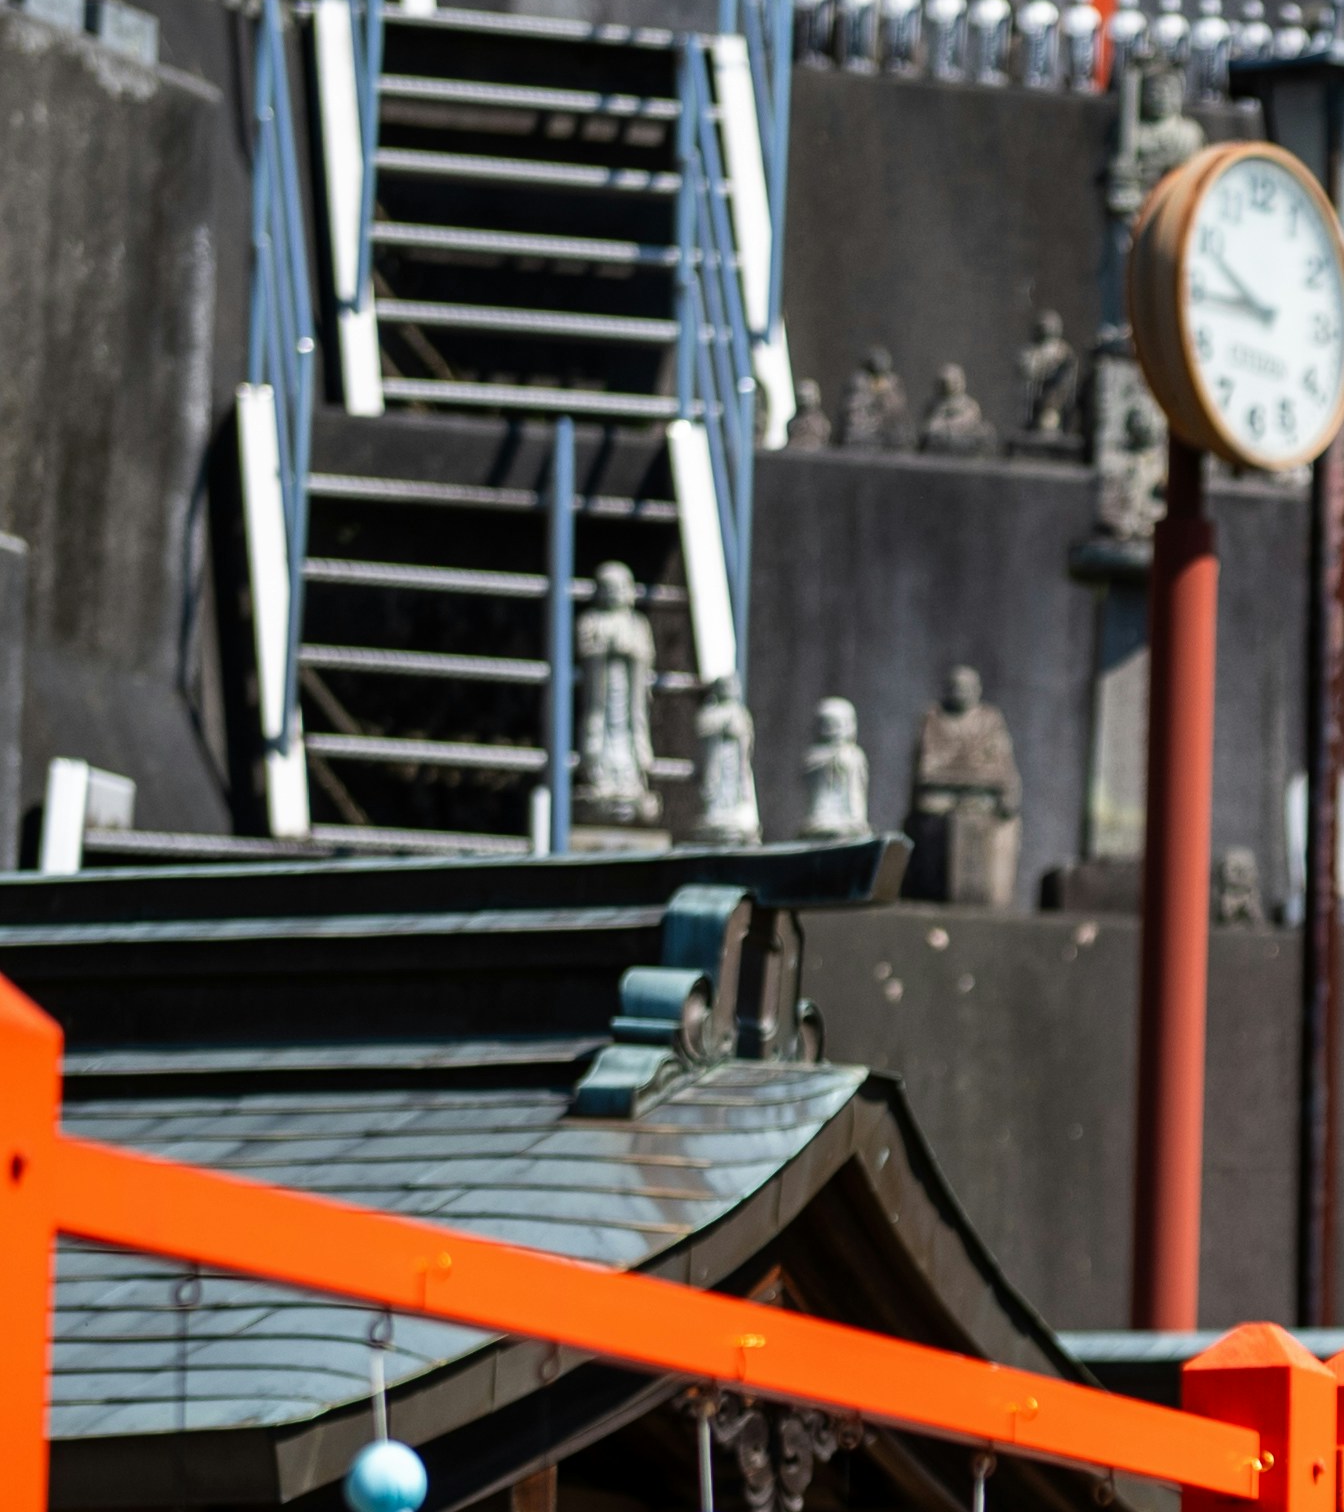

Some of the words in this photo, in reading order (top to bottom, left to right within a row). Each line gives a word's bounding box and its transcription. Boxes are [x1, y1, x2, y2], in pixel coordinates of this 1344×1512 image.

[1249, 175, 1276, 213] 12
[1304, 258, 1324, 289] 2
[1246, 405, 1265, 440] 6
